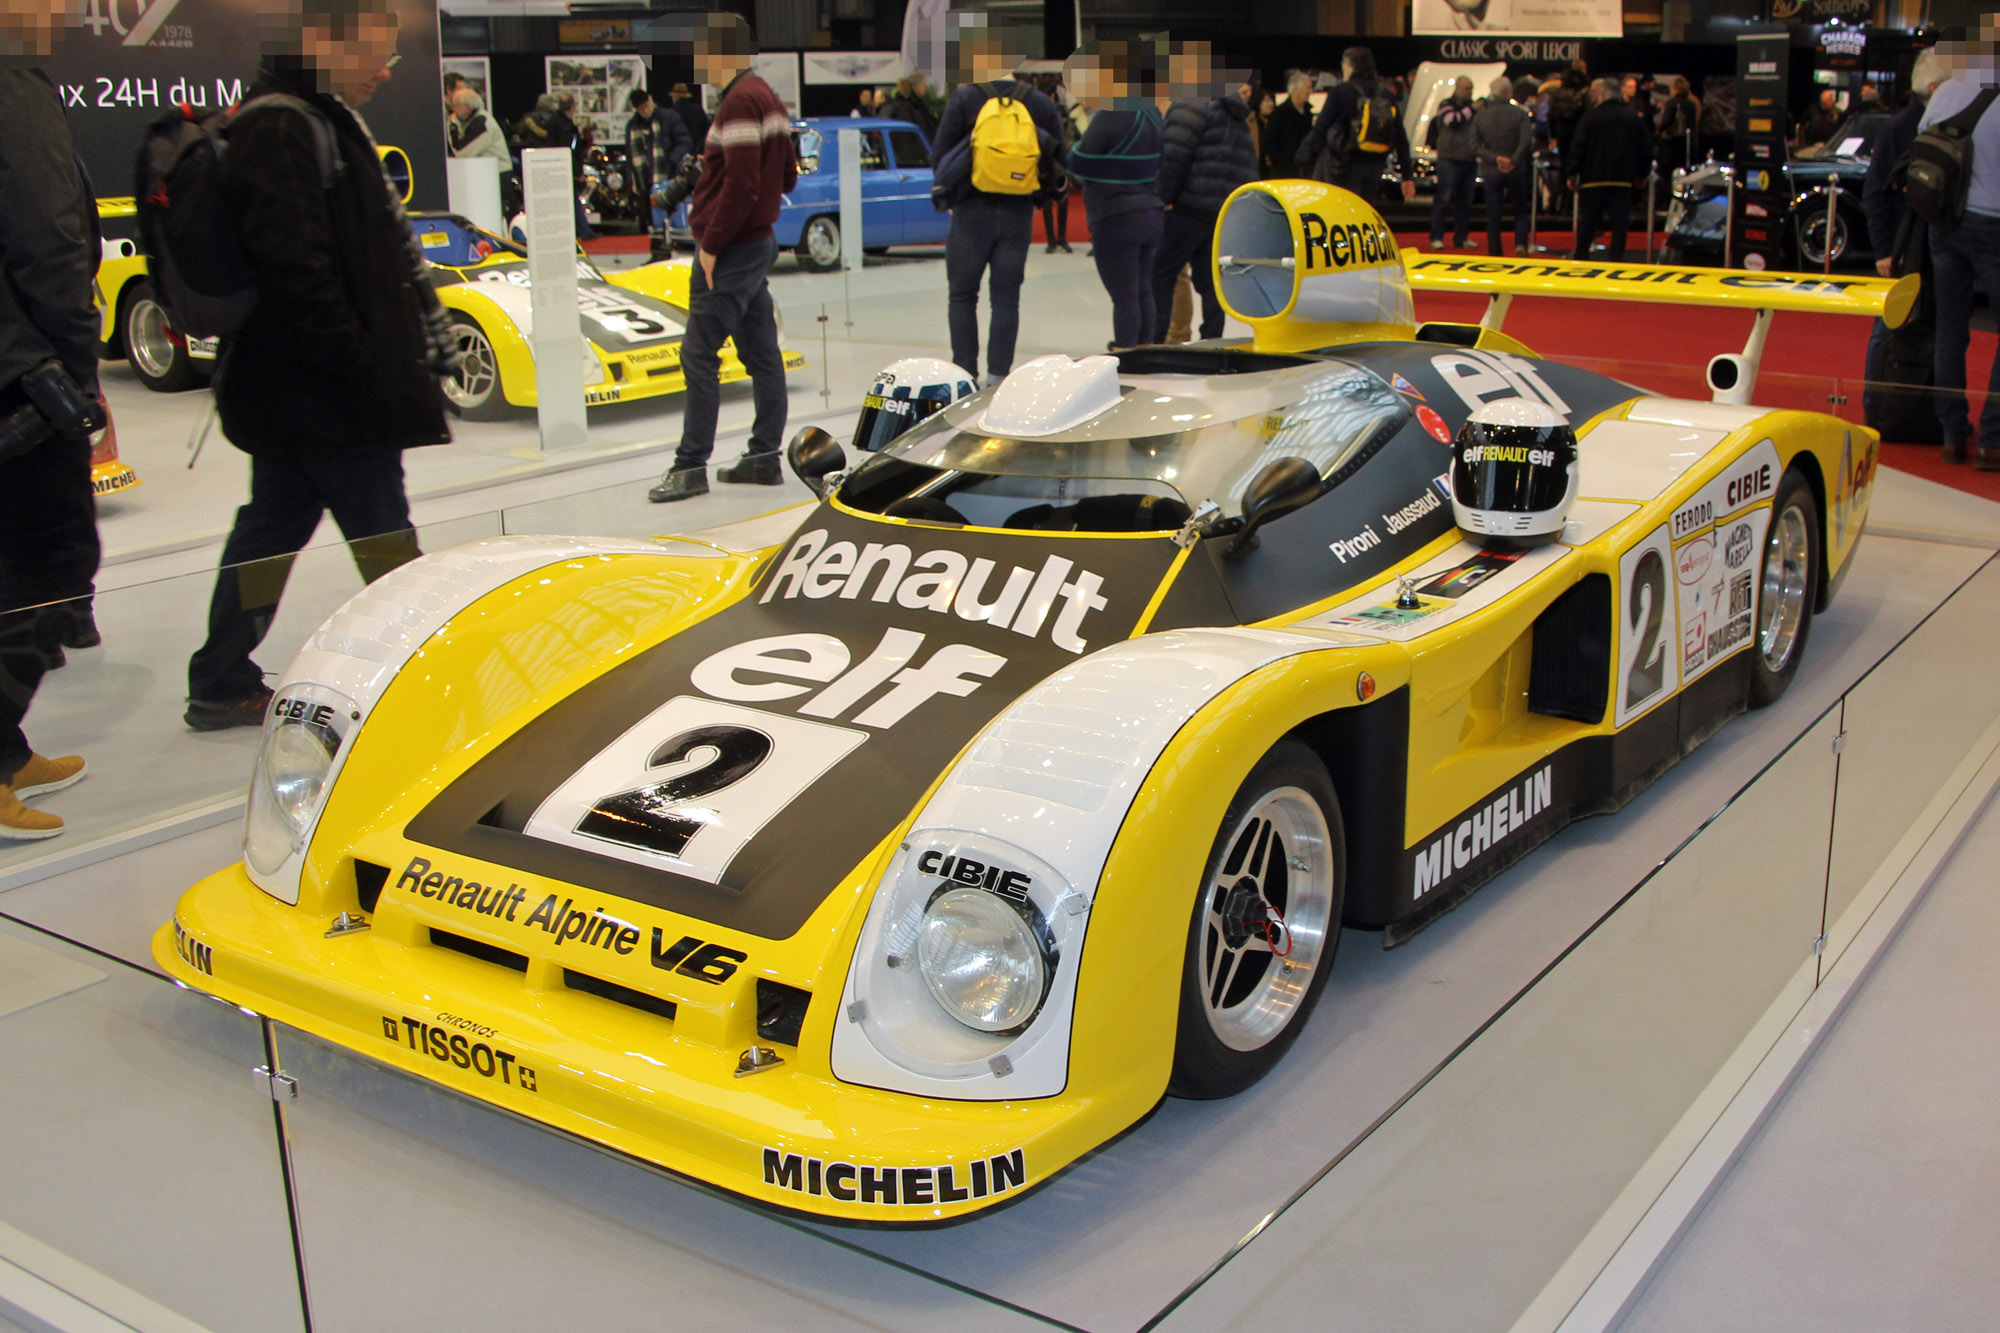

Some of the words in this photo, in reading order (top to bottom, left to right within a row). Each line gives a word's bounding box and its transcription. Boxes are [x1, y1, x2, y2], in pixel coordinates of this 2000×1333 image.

[163, 26, 192, 38] 1978
[1441, 40, 1490, 59] CLASSIC
[1496, 41, 1538, 60] SPORT
[95, 77, 159, 107] 24H
[168, 76, 206, 107] du
[215, 78, 249, 107] M
[1412, 260, 1703, 285] Renault
[602, 310, 664, 334] 3
[626, 349, 671, 364] Renault
[1430, 348, 1573, 416] elf
[884, 399, 911, 415] elf
[1463, 446, 1483, 463] elf
[1483, 446, 1529, 462] RENAULT
[1528, 449, 1555, 467] elf
[1329, 524, 1382, 564] Pironi
[1382, 487, 1442, 535] Jaussaud
[1675, 500, 1713, 536] FERODO
[758, 528, 1109, 655] Renault
[1624, 547, 1667, 714] 2
[690, 626, 1009, 730] elf
[571, 723, 776, 859] 2
[1413, 763, 1552, 901] MICHELIN
[395, 856, 526, 923] Renault
[524, 894, 641, 956] Alpine
[650, 926, 748, 985] V6
[436, 1011, 499, 1039] CHRONOS
[401, 1016, 516, 1085] TISSOT
[763, 1147, 1026, 1205] MICHELIN
